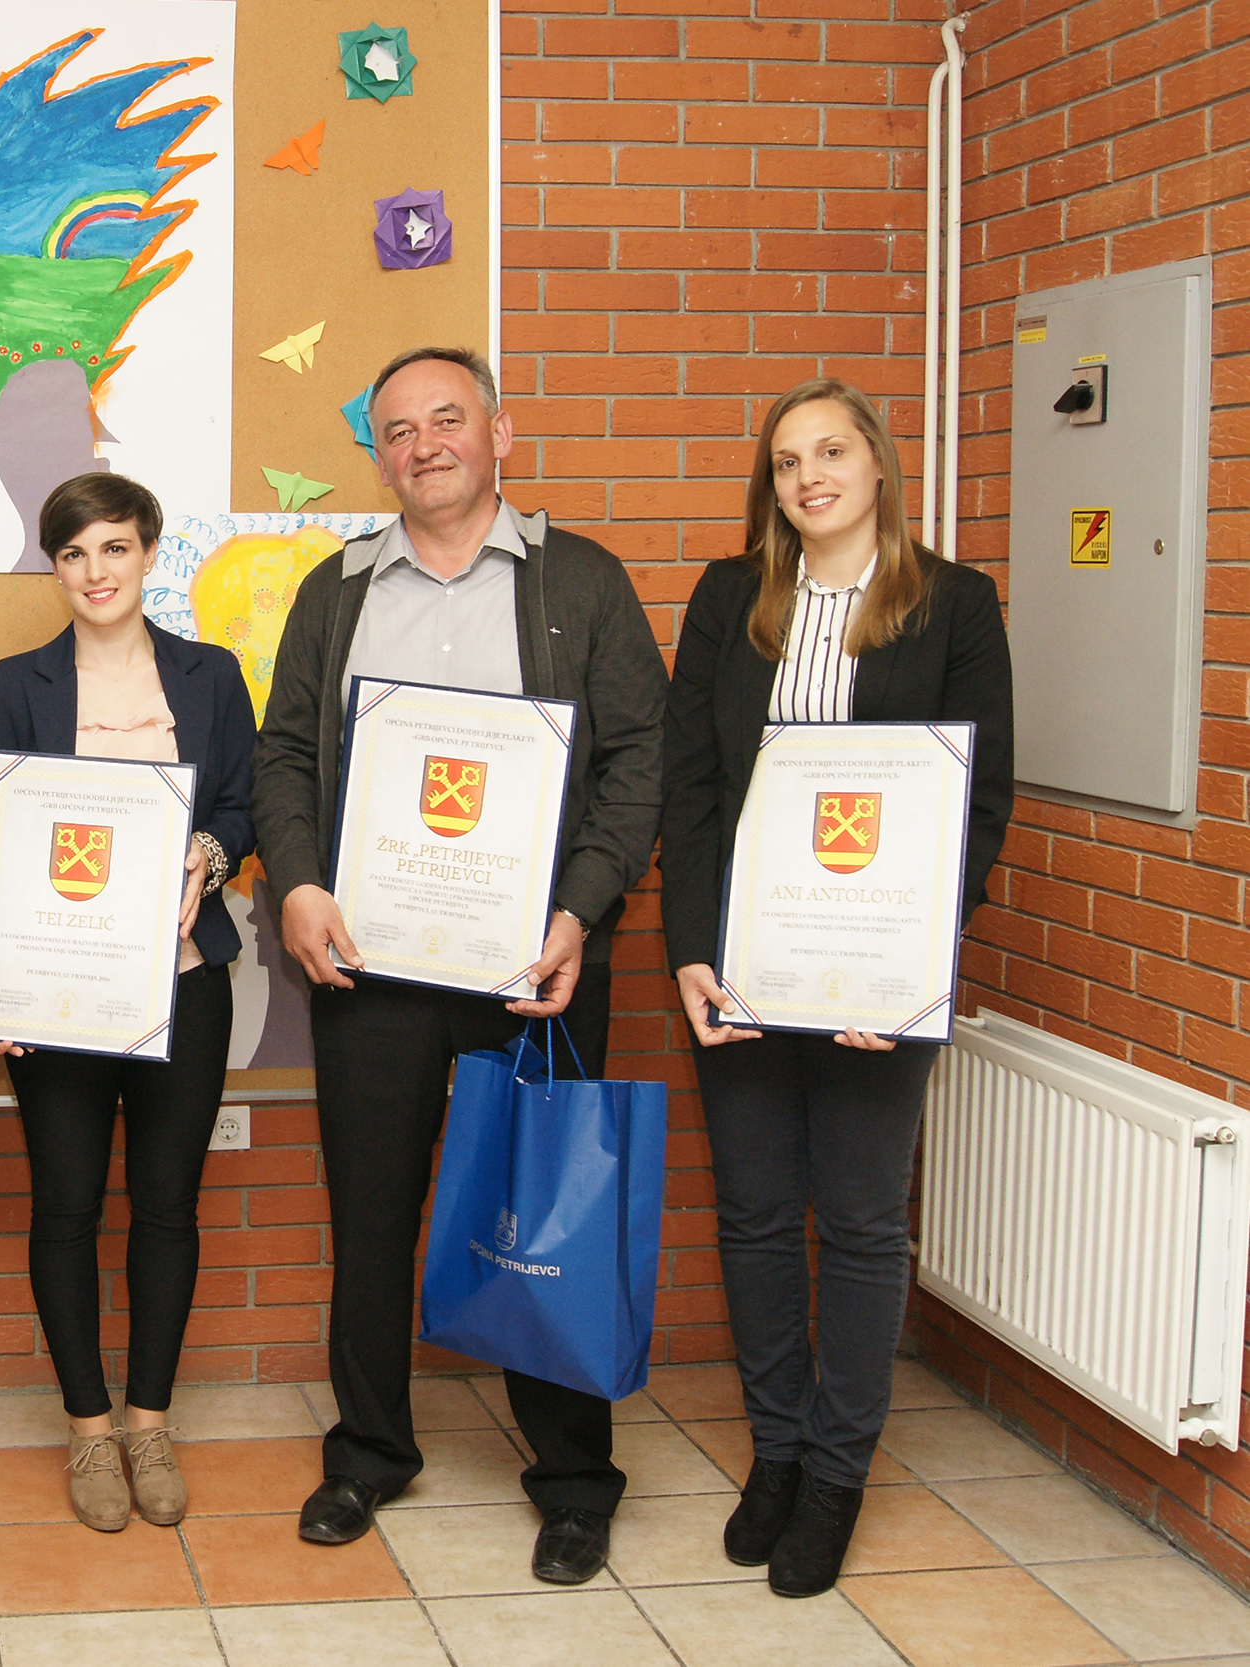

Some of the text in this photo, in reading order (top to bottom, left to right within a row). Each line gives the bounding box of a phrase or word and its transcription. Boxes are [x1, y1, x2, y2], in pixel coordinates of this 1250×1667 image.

[1091, 550, 1107, 560] NAPON
[414, 721, 456, 733] PETRIJEVCI
[502, 733, 537, 744] PLAKETU
[41, 790, 82, 800] PETRIJEVCI
[125, 797, 160, 806] PLAKETU
[376, 834, 411, 855] ŽRK
[396, 857, 492, 885] PETRIJEVCI
[770, 884, 917, 905] ANI ANTOLOVIĆ
[34, 910, 116, 931] TEI ZELIĆ
[495, 1255, 561, 1277] PETRIJEVCI
